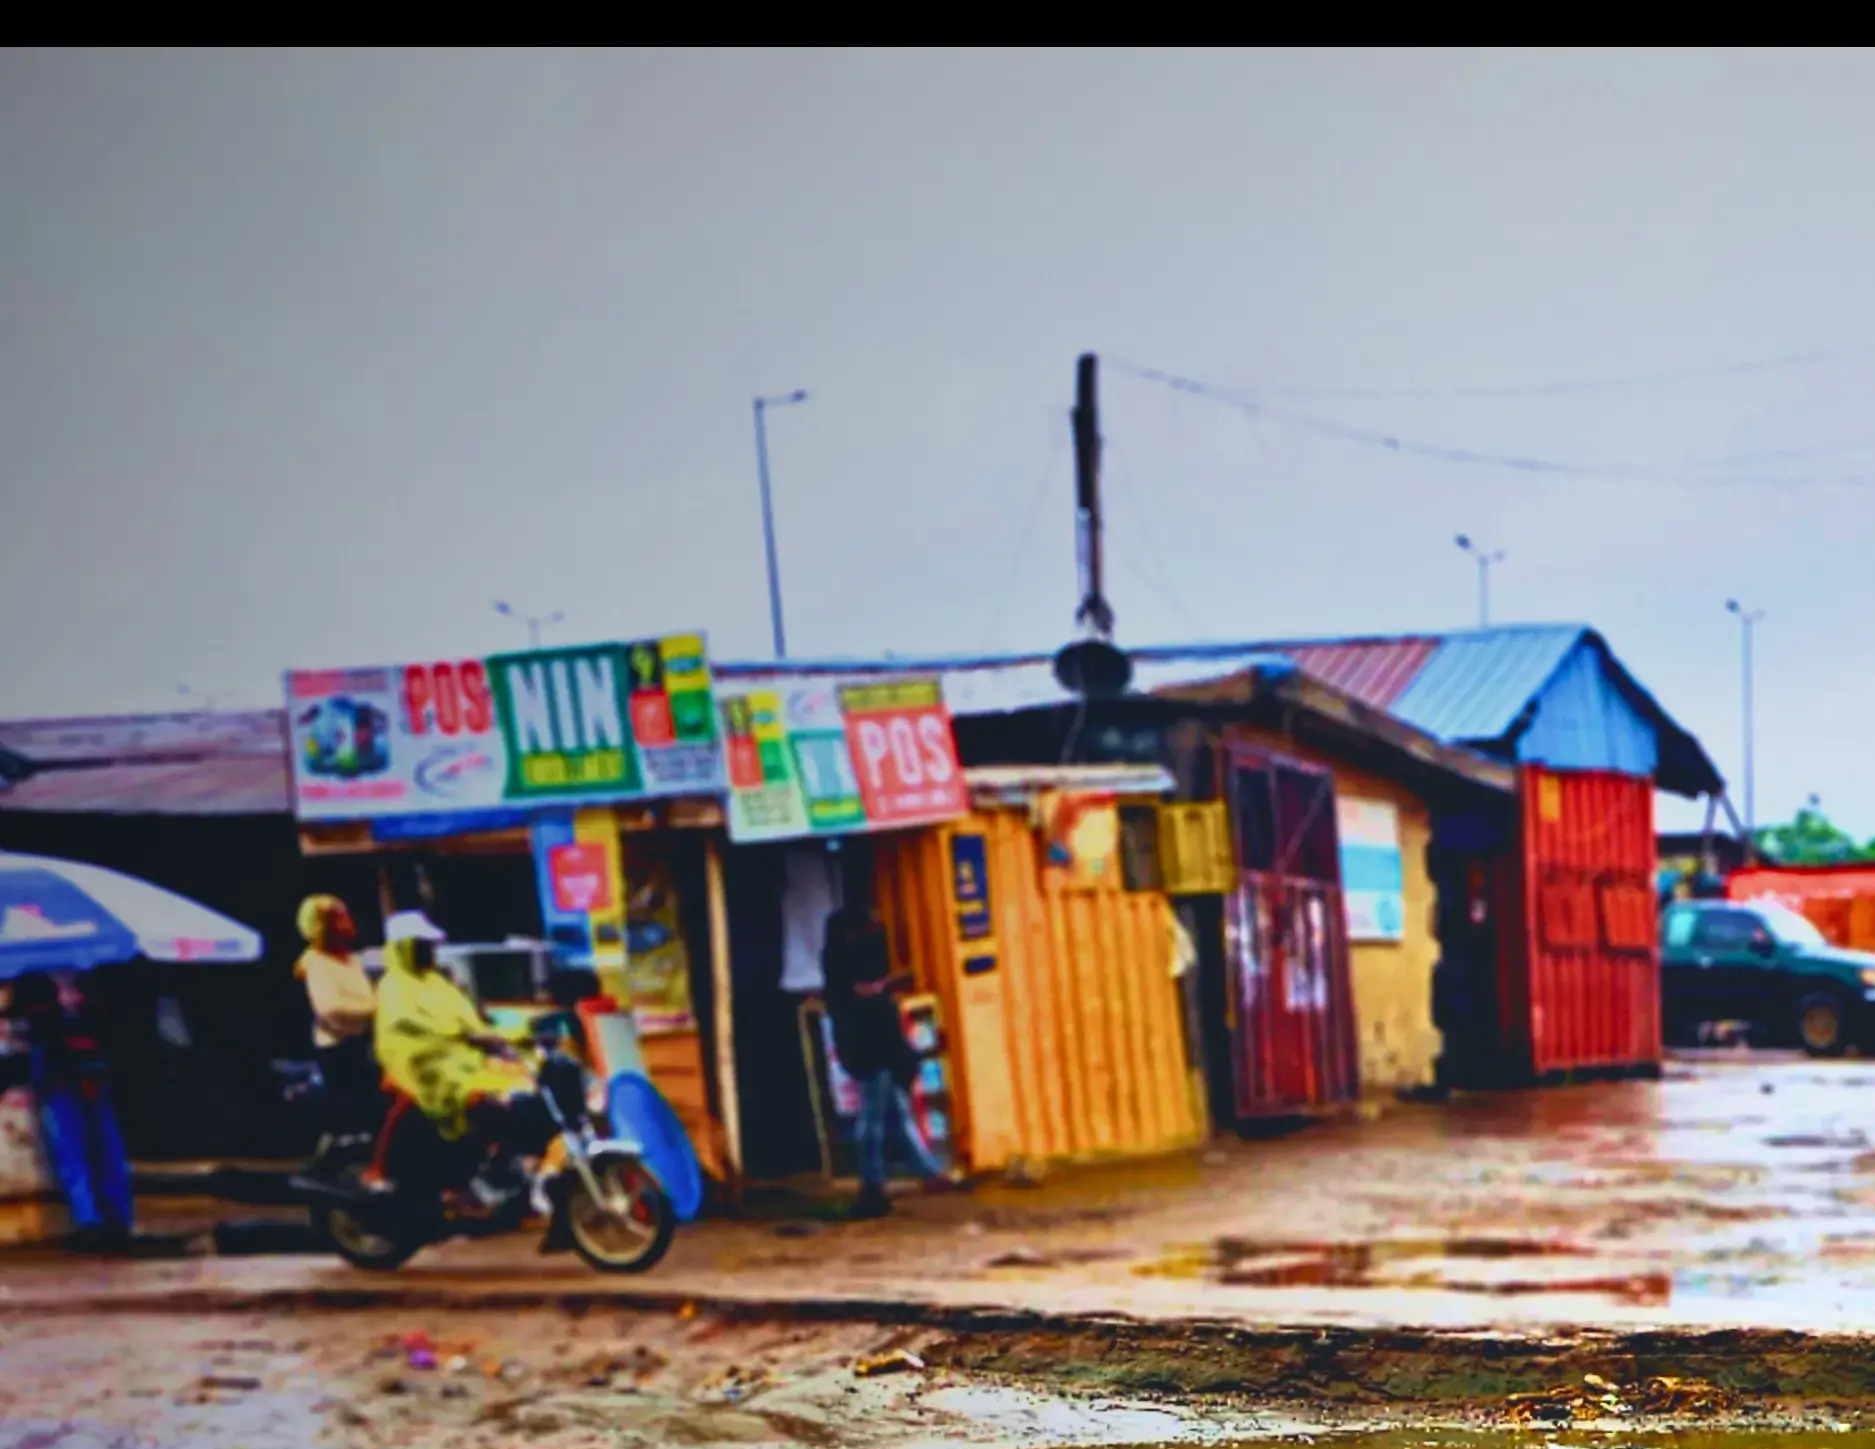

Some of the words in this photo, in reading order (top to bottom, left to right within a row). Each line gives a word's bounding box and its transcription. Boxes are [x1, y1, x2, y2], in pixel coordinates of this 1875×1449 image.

[403, 658, 494, 737] POS
[508, 655, 623, 753] NIN
[858, 715, 952, 788] POS
